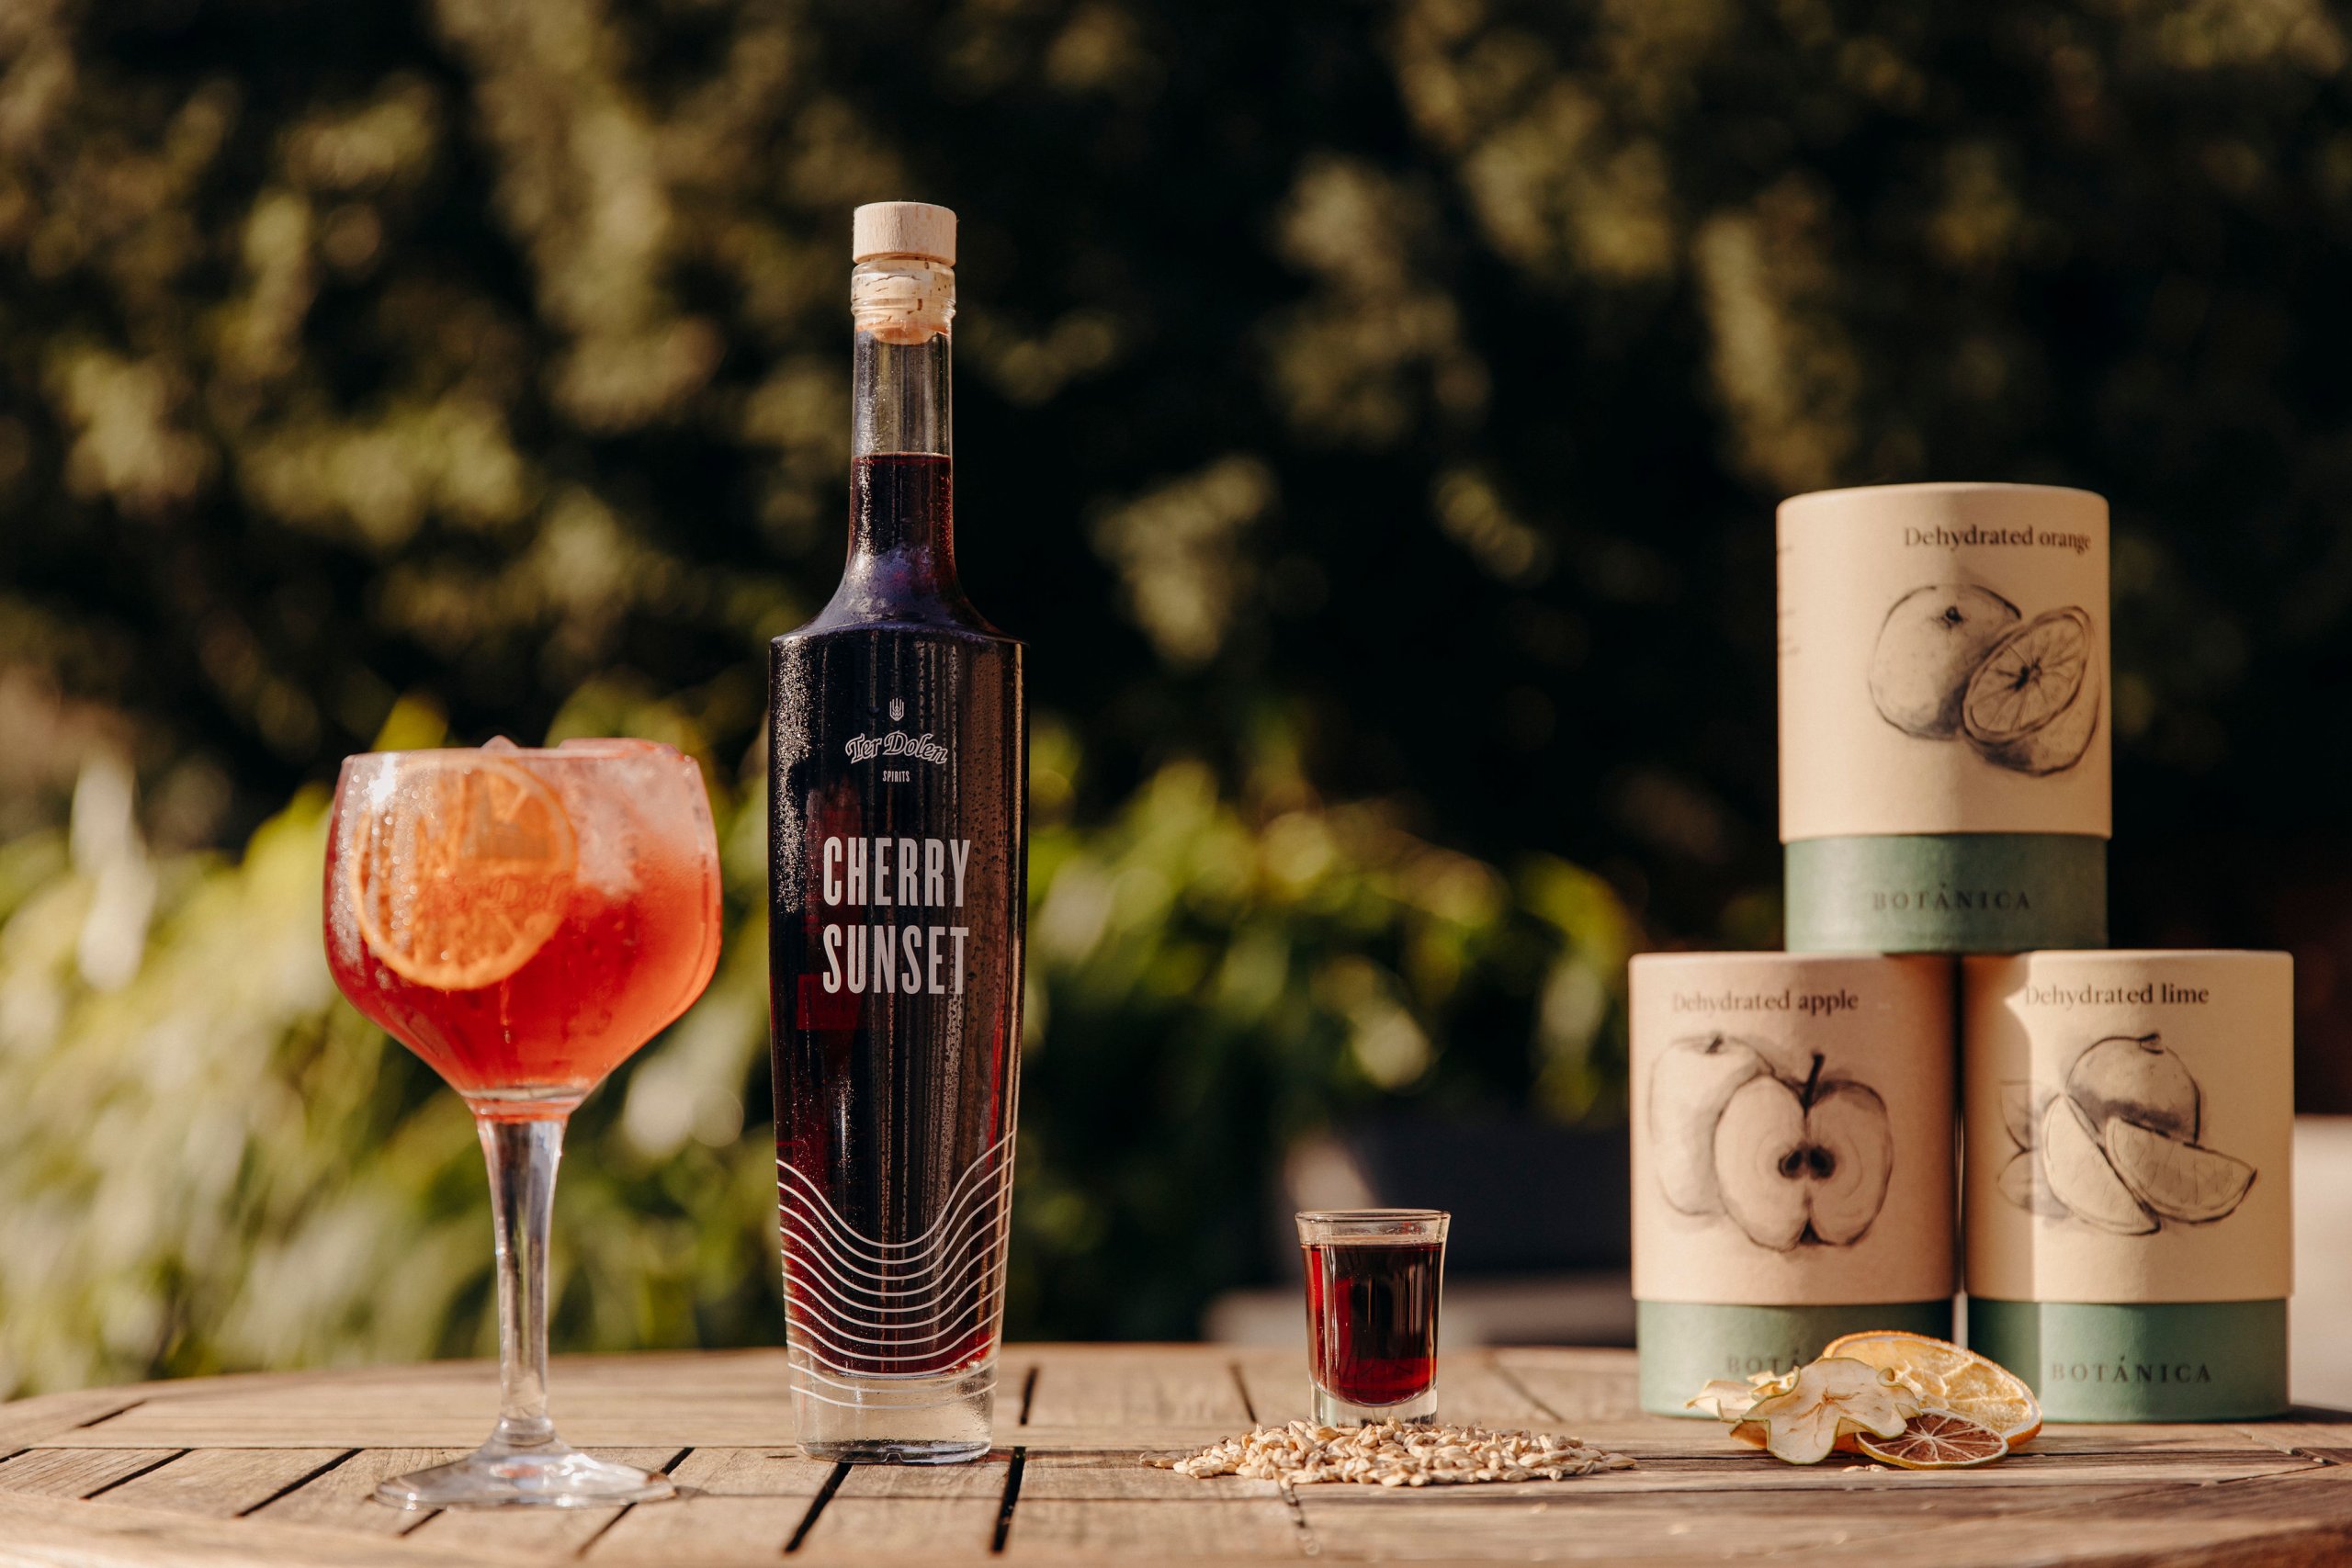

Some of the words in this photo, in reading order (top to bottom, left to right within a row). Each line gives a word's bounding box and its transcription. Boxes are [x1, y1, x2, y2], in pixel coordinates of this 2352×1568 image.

[1904, 525, 2033, 554] Dehydrated
[2041, 531, 2091, 555] orange
[845, 732, 883, 765] Ter
[884, 730, 948, 764] Dolen
[882, 770, 910, 783] SPIRITS
[823, 838, 971, 908] CHERRY
[1873, 882, 2031, 909] BOTÁNICA
[822, 925, 969, 995] SUNSET
[1673, 989, 1790, 1015] Dehydrated
[1798, 989, 1859, 1016] apple
[2024, 984, 2154, 1010] Dehydrated
[2161, 984, 2210, 1004] lime
[2052, 1355, 2211, 1382] BOTÁNICA
